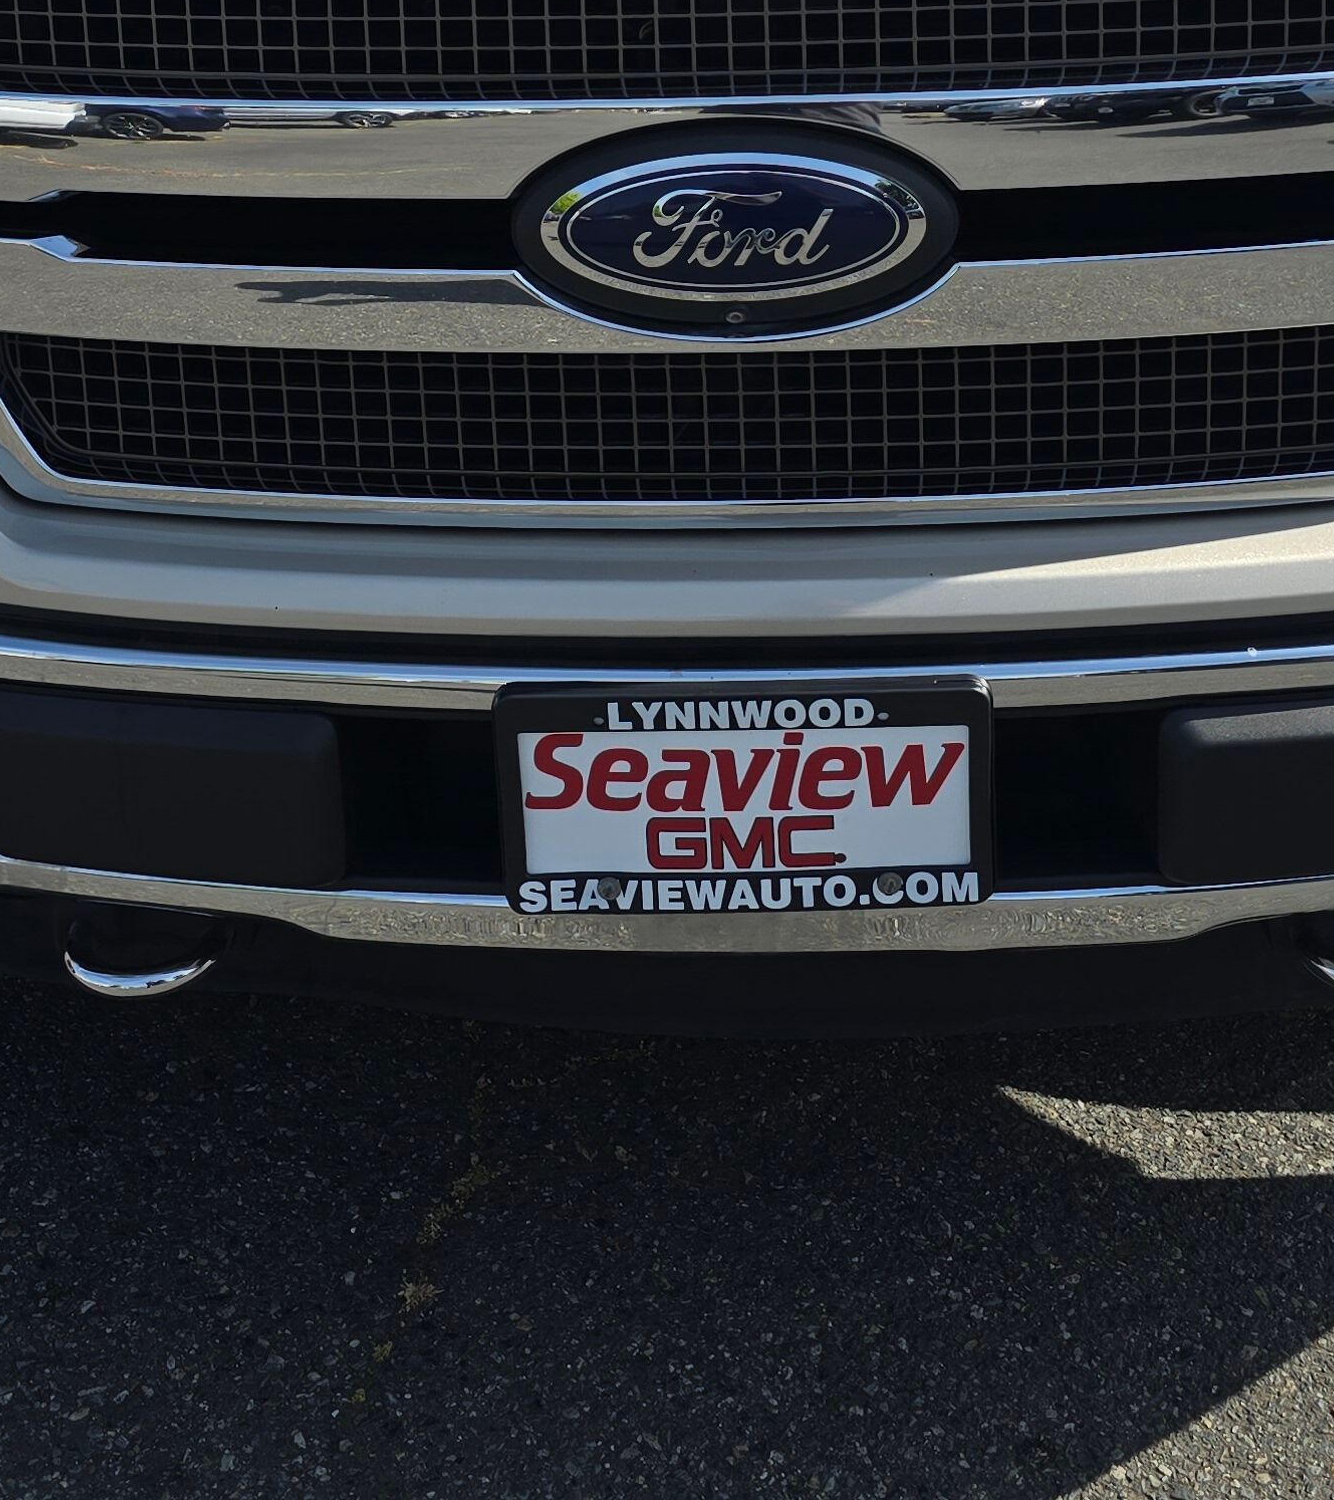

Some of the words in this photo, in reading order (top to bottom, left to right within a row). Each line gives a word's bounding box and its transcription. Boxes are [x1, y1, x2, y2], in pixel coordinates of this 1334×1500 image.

[632, 189, 834, 268] Ford
[607, 698, 875, 731] LYNNWOOD
[524, 732, 966, 812] Seaview
[645, 814, 836, 870] GMC
